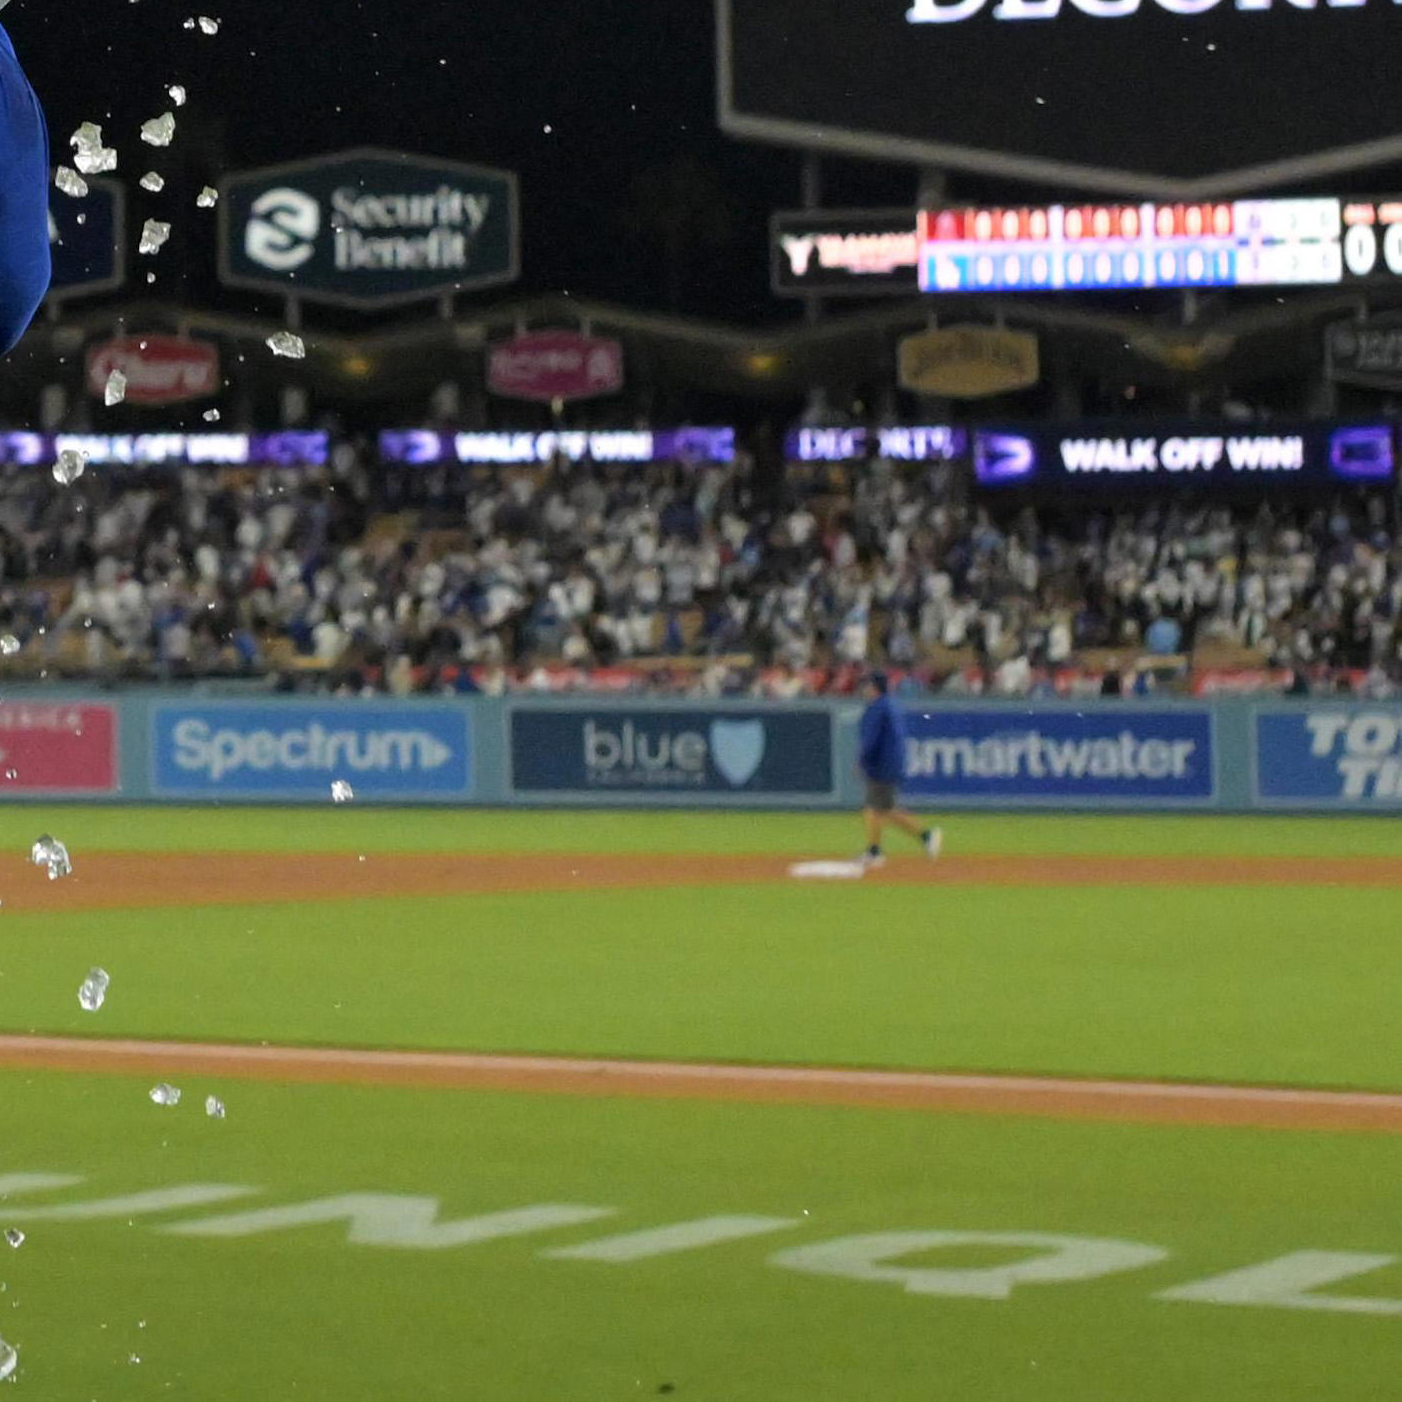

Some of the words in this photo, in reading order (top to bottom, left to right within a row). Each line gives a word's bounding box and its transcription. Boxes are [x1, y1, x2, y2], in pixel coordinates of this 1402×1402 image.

[330, 184, 490, 234] Security
[335, 227, 467, 271] Benefit
[1059, 437, 1158, 472] WALK
[1160, 436, 1225, 472] OFF
[1226, 435, 1305, 471] WIN!
[172, 718, 428, 781] Spectrum
[582, 718, 707, 772] blue
[1307, 713, 1402, 757] TO
[1337, 758, 1402, 798] TI
